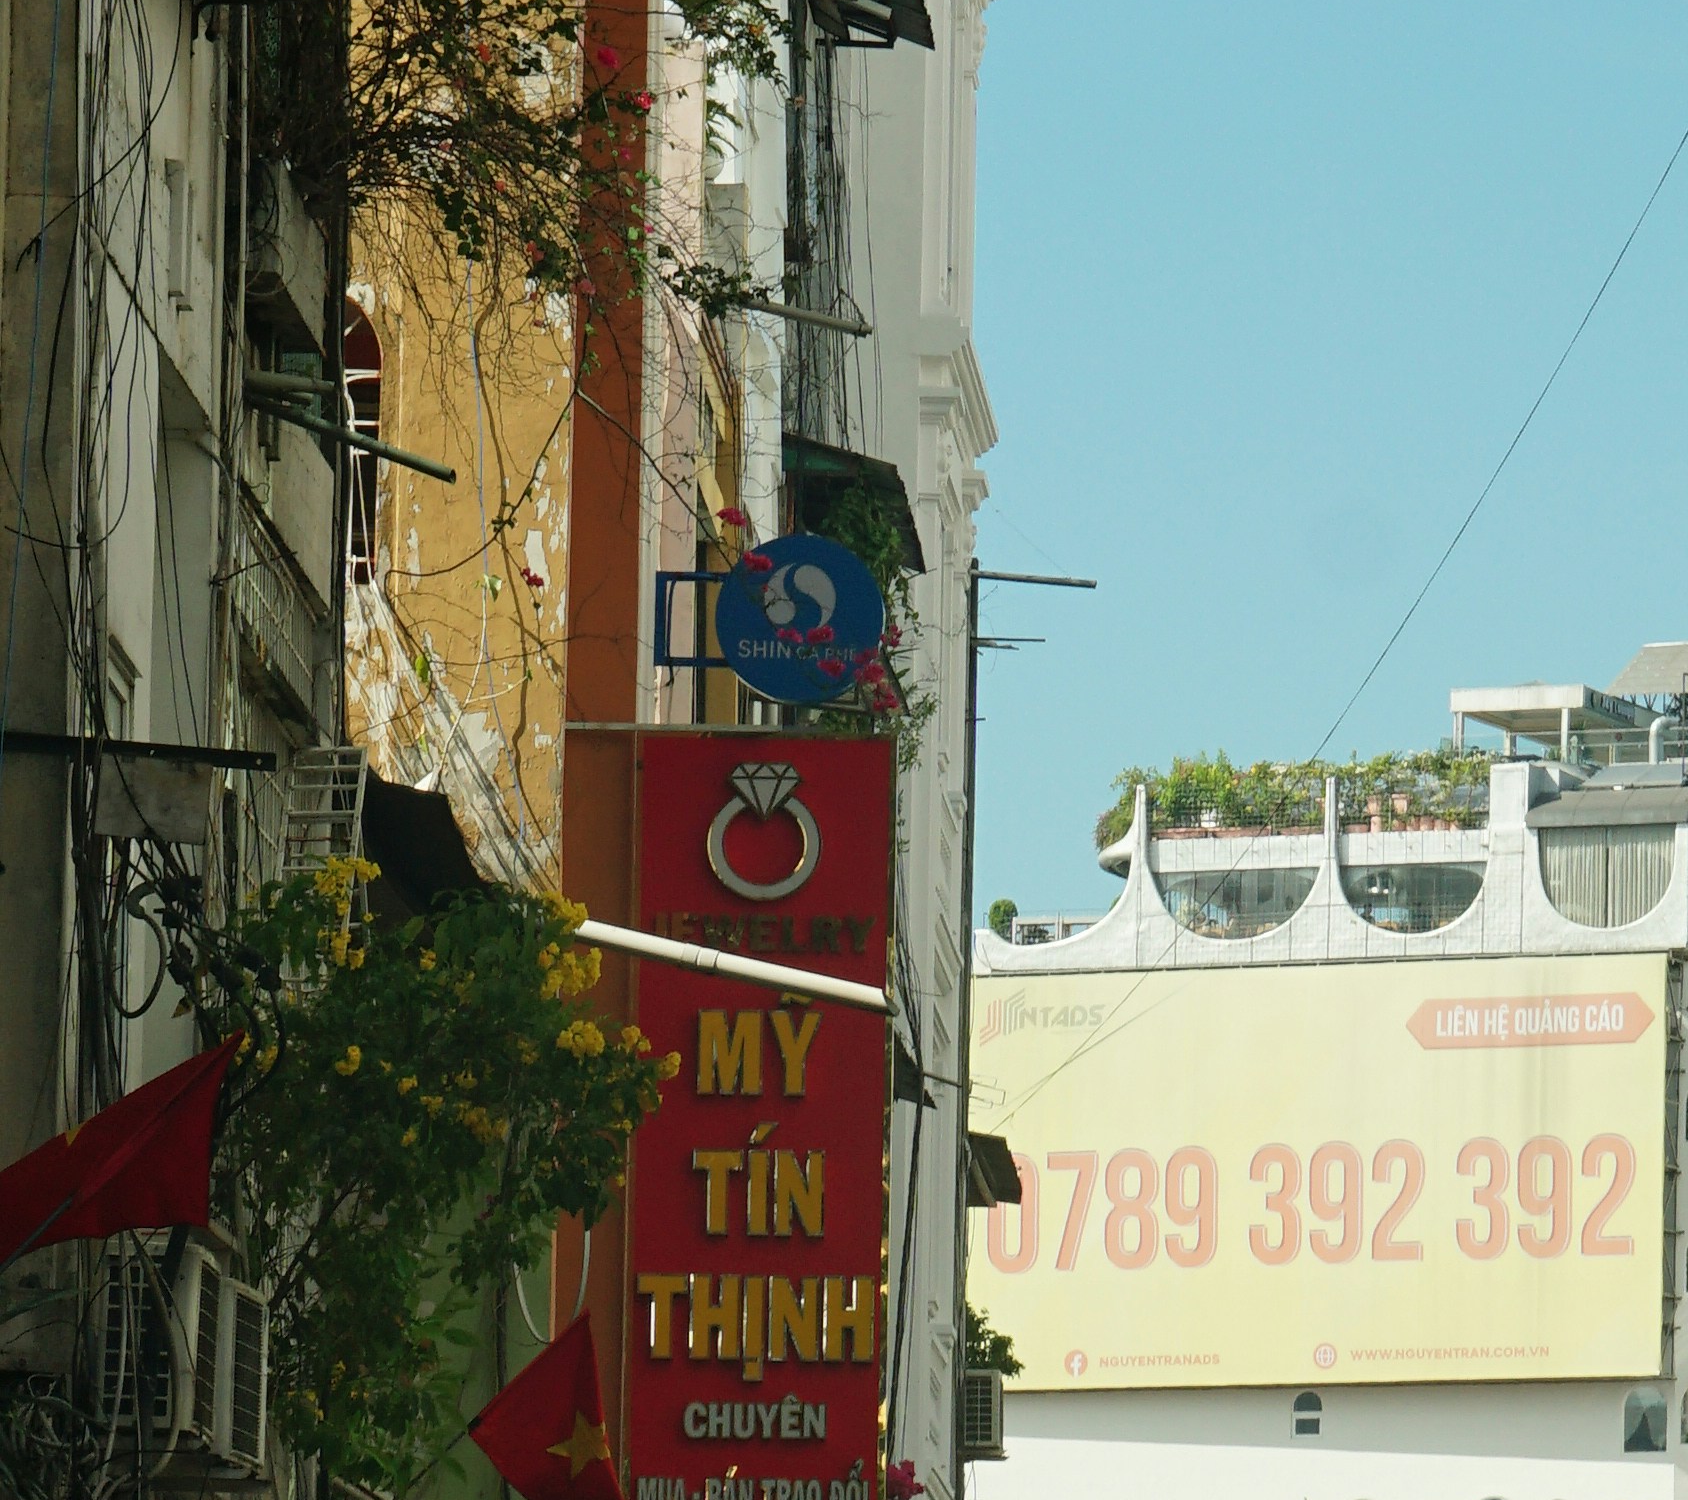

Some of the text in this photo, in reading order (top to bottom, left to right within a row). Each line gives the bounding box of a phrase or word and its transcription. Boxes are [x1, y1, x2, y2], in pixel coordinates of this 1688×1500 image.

[738, 639, 791, 660] SHIN
[696, 990, 824, 1097] MỸ
[1435, 997, 1624, 1042] LIÊN HỆ QUẢNG CÁO
[692, 1120, 826, 1239] TÍN
[985, 1132, 1638, 1275] 0789 392 392
[635, 1272, 876, 1384] THỊNH
[1099, 1345, 1551, 1369] NGUYENTRANADS WWW.NGUYENTRAN.COM.VN
[682, 1391, 828, 1441] CHUYÊN
